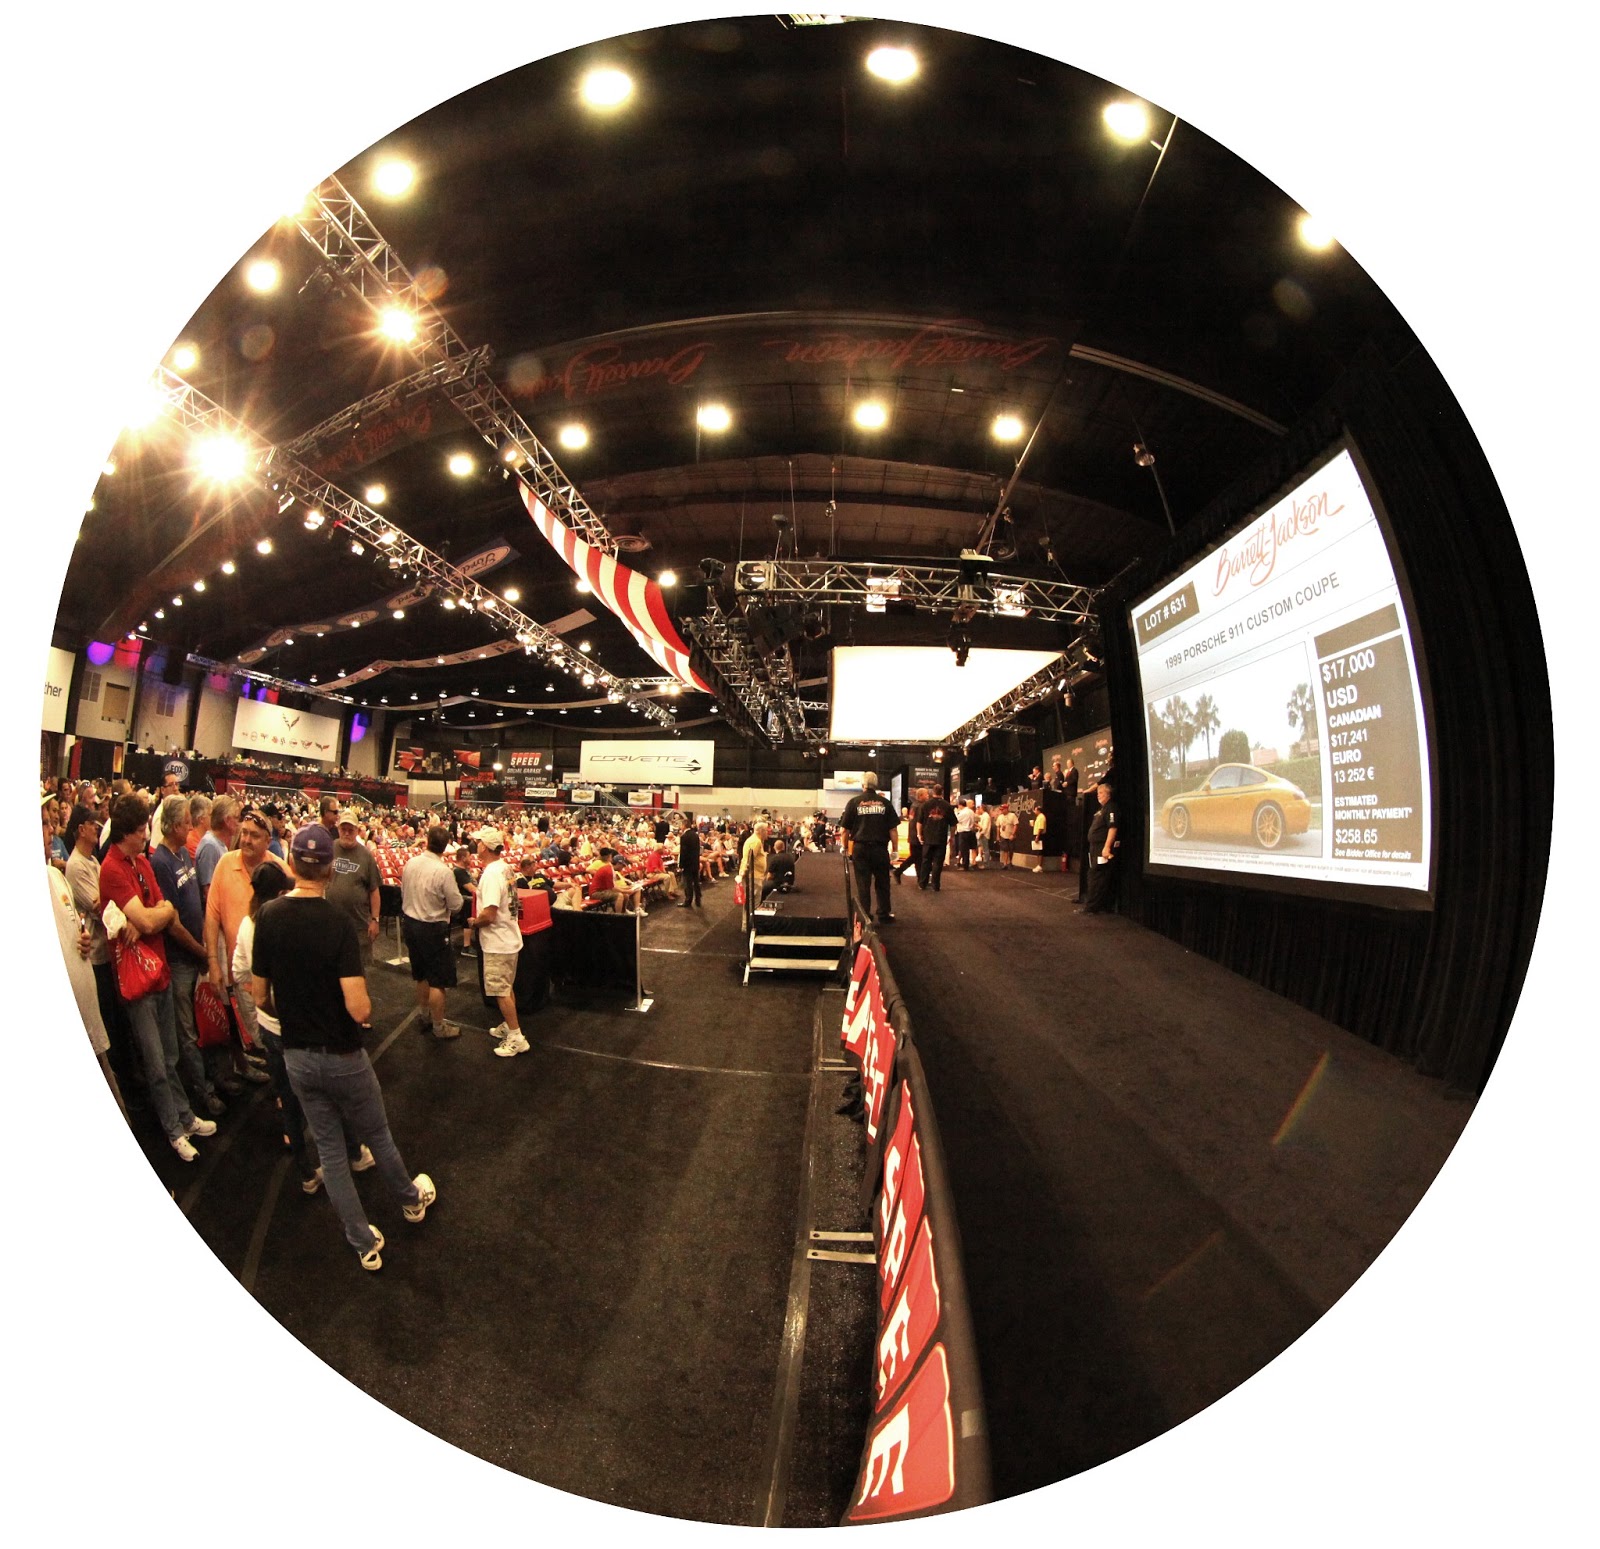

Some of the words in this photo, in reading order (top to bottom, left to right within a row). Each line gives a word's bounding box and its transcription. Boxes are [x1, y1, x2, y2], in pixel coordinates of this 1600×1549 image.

[460, 552, 496, 575] Ford
[1144, 609, 1161, 631] LOT
[1163, 604, 1170, 620] #
[1170, 594, 1186, 615] 631
[1165, 654, 1182, 670] 1999
[1184, 630, 1228, 662] PORSCHE
[1228, 623, 1245, 640] 911
[1246, 598, 1293, 631] CUSTOM
[1295, 572, 1340, 606] COUPE
[1322, 648, 1375, 683] $17,000
[1326, 684, 1358, 708] USD
[1329, 704, 1382, 728] CANADIAN
[1330, 728, 1368, 748] $17,241
[510, 757, 540, 766] SPEED
[1332, 748, 1362, 765] EURO
[170, 764, 183, 774] FOX
[1334, 769, 1346, 783] 13
[1347, 767, 1365, 783] 252
[1334, 794, 1378, 807] ESTIMATED
[858, 805, 886, 815] SECURITY
[1334, 808, 1370, 820] MONTHLY
[1335, 828, 1378, 845] $258.65
[1334, 848, 1345, 857] See
[1345, 848, 1364, 858] Bidder
[1364, 849, 1381, 858] Office
[1382, 849, 1391, 859] for
[1391, 850, 1411, 860] details
